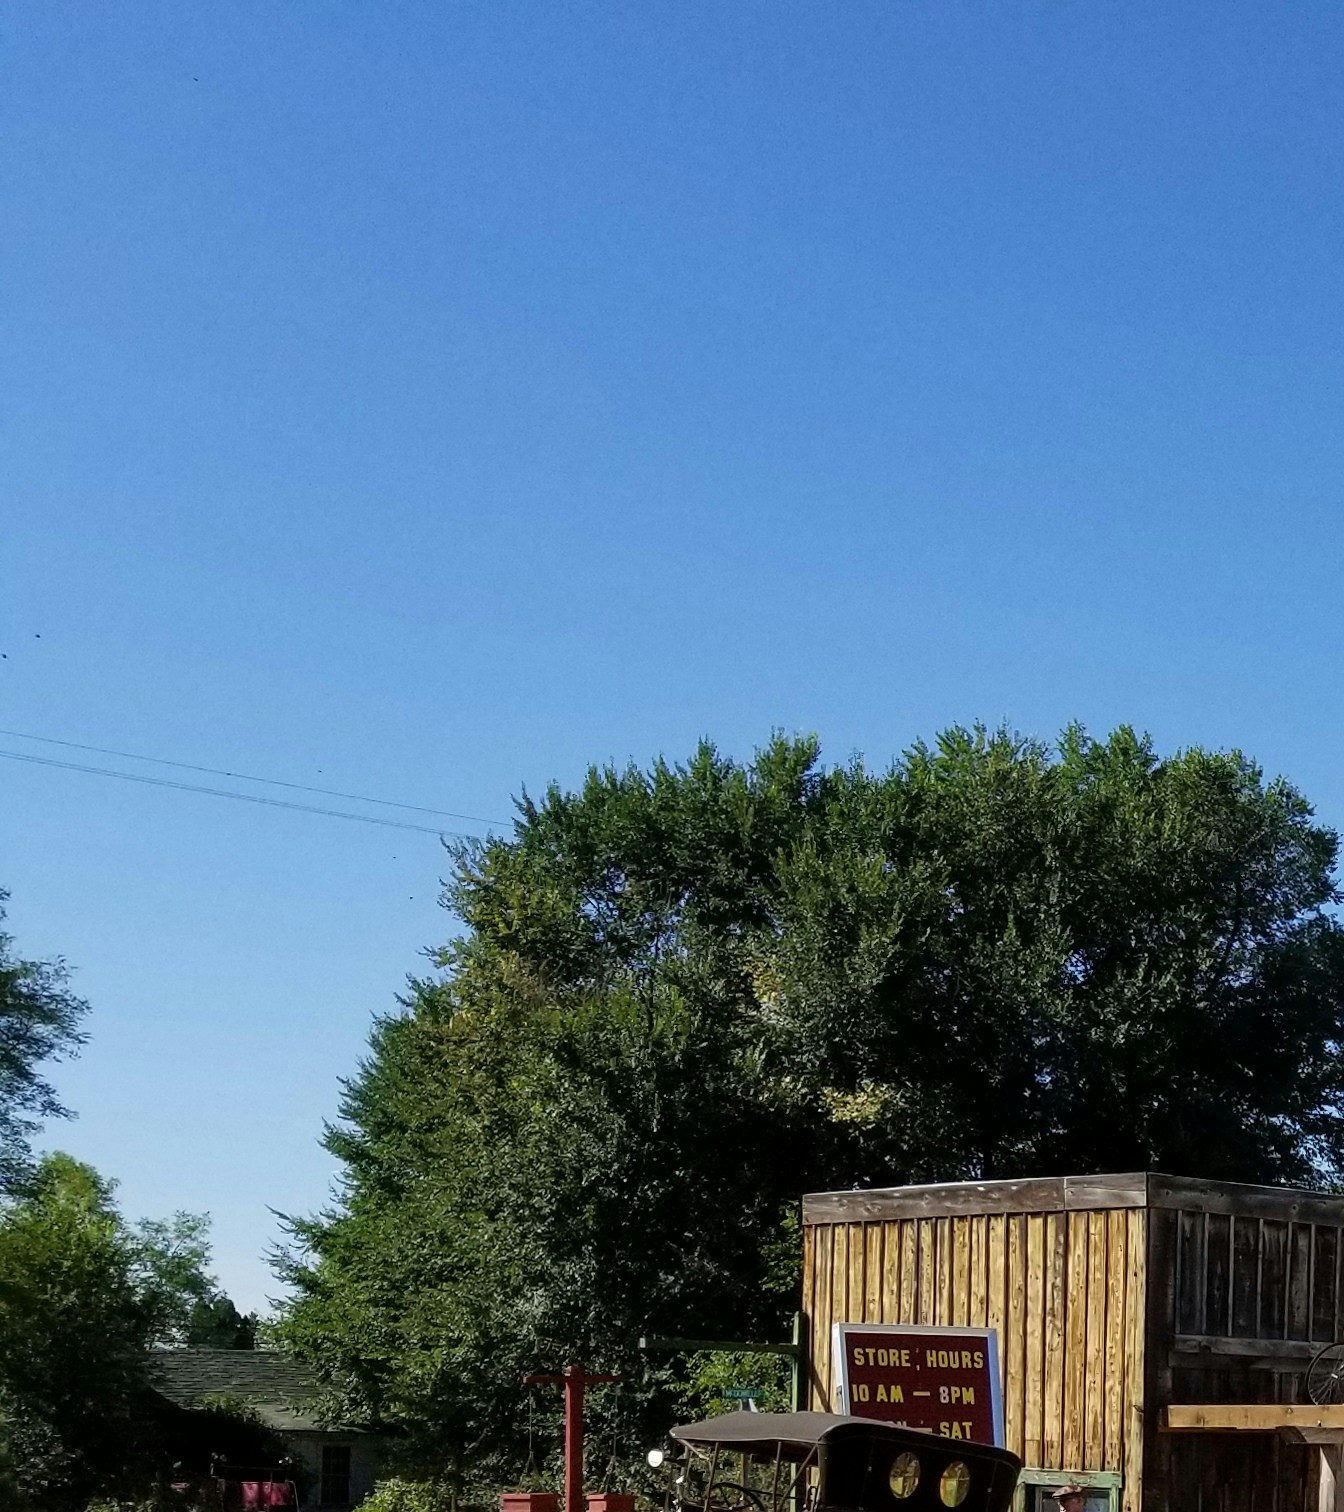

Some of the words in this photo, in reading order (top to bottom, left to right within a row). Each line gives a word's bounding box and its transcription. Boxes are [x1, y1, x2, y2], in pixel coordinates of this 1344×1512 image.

[853, 1348, 911, 1367] STORE
[926, 1350, 984, 1369] HOURS
[852, 1384, 869, 1402] 10
[876, 1384, 904, 1403] AM
[939, 1421, 973, 1440] SAT
